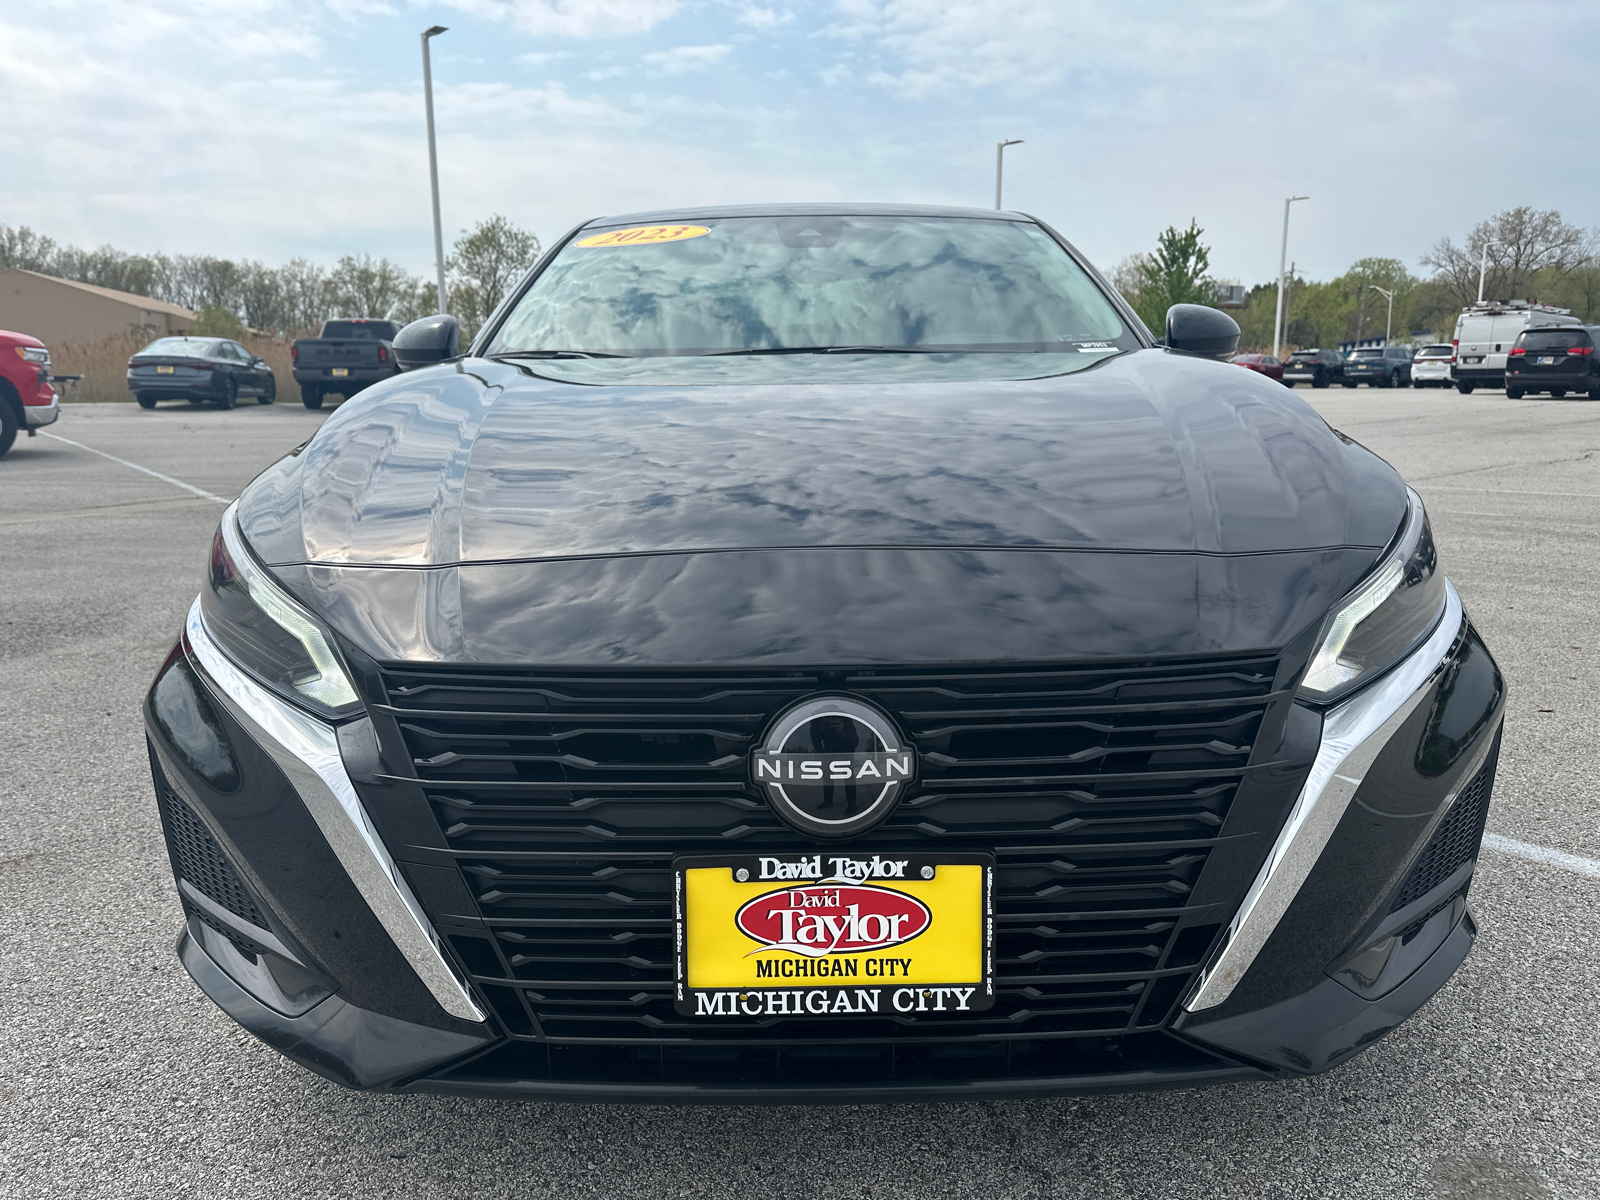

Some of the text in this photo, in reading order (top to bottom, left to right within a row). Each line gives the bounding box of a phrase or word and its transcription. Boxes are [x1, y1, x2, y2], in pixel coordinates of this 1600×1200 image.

[592, 226, 690, 246] 2023
[758, 756, 909, 780] NISSAN
[758, 855, 909, 885] David Taylor
[788, 889, 841, 908] David
[766, 903, 909, 956] Taylor
[756, 958, 912, 978] MICHIGAN CITY
[694, 987, 976, 1016] MICHIGAN CITY
